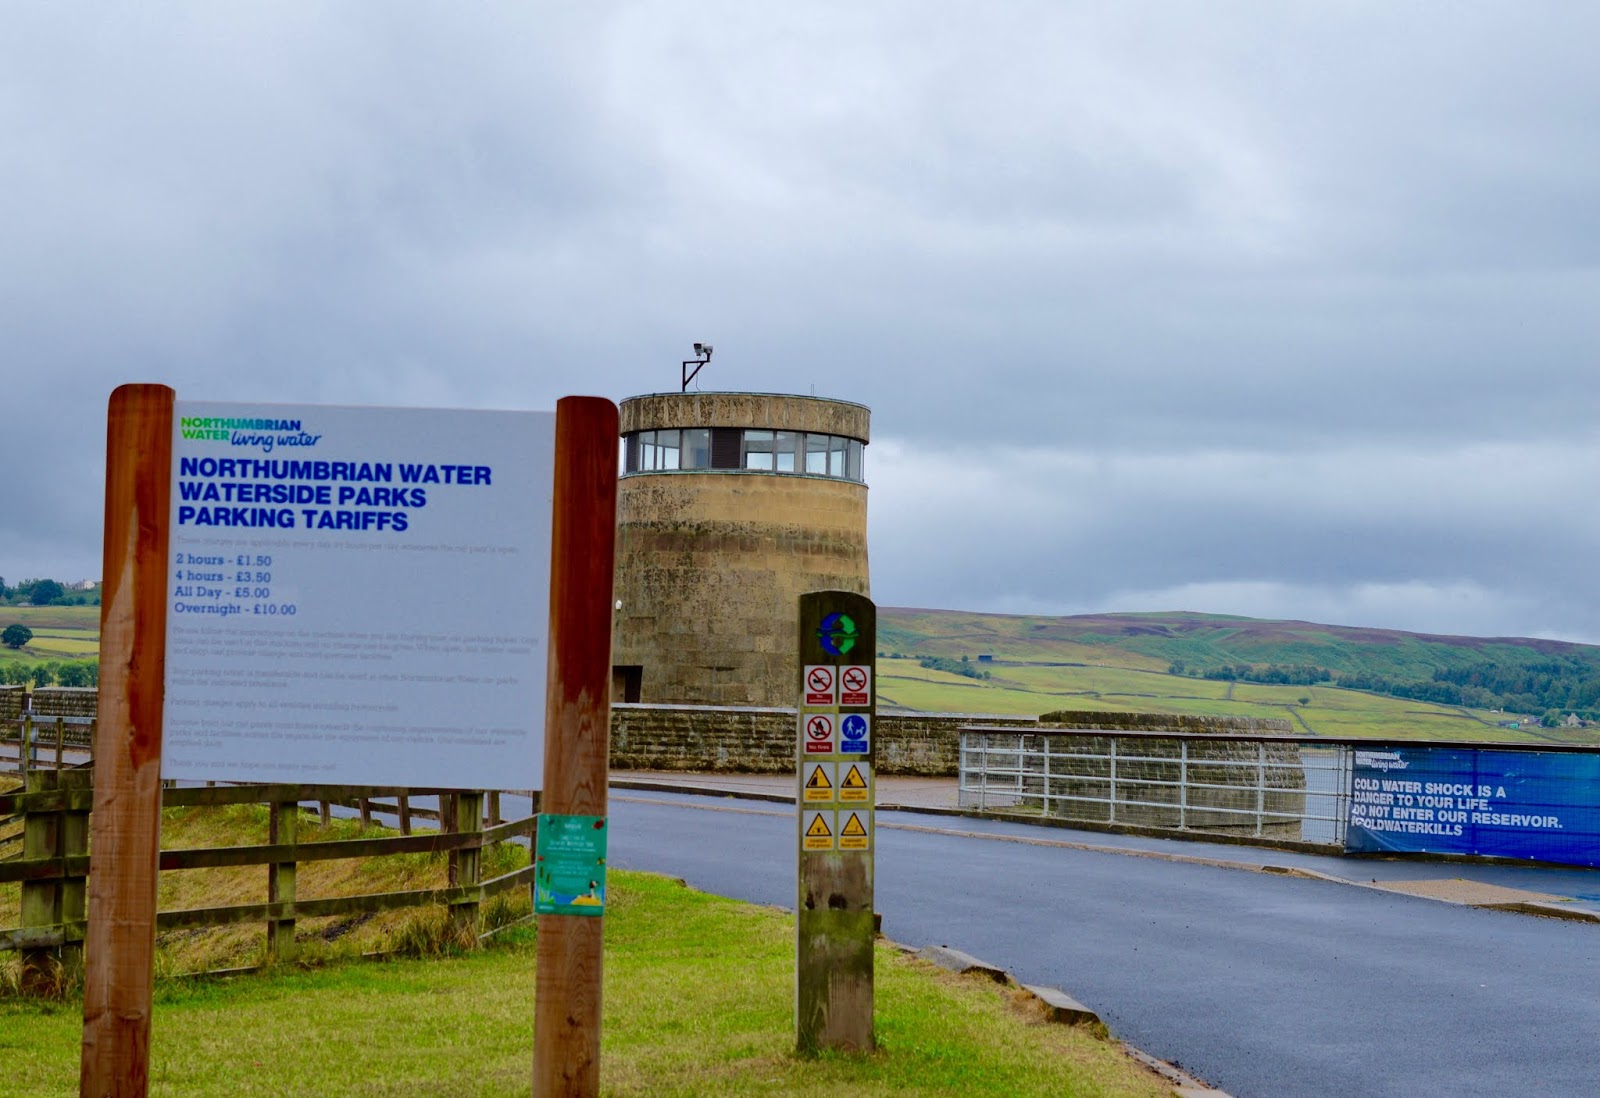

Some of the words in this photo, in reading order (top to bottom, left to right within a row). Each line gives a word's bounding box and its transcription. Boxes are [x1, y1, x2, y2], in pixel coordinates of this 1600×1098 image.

[180, 416, 302, 431] NORTHUMBRIAN
[181, 429, 230, 441] WATER
[231, 430, 274, 453] living
[277, 431, 322, 446] water
[180, 457, 393, 483] NORTHUMBRIAN
[398, 464, 492, 486] WATER
[178, 481, 332, 505] WATERSIDE
[338, 486, 427, 508] PARKS
[178, 506, 296, 529] PARKING
[301, 509, 409, 532] TARIFFS
[176, 553, 184, 564] 2
[187, 553, 224, 565] hours
[236, 555, 272, 567] £1.50
[175, 570, 183, 581] 4
[186, 570, 224, 582] hours
[235, 571, 272, 583] £3.50
[174, 586, 193, 597] All
[196, 586, 222, 600] Day
[234, 587, 270, 598] £5.00
[174, 602, 241, 616] Overnight
[253, 604, 296, 616] £10.00
[1354, 778, 1379, 791] COLD
[1382, 779, 1422, 793] WATER
[1425, 782, 1473, 796] SHOCK
[1477, 785, 1492, 797] IS
[1495, 786, 1507, 798] A
[1354, 791, 1394, 805] DANGER
[1397, 794, 1413, 806] TO
[1416, 796, 1454, 809] YOUR
[1457, 798, 1493, 811] LIFE.
[1351, 804, 1366, 816] DO
[1369, 805, 1390, 818] NOT
[1393, 807, 1434, 821] ENTER
[1437, 810, 1467, 823] OUR
[1471, 812, 1563, 829] RESERVOIR.
